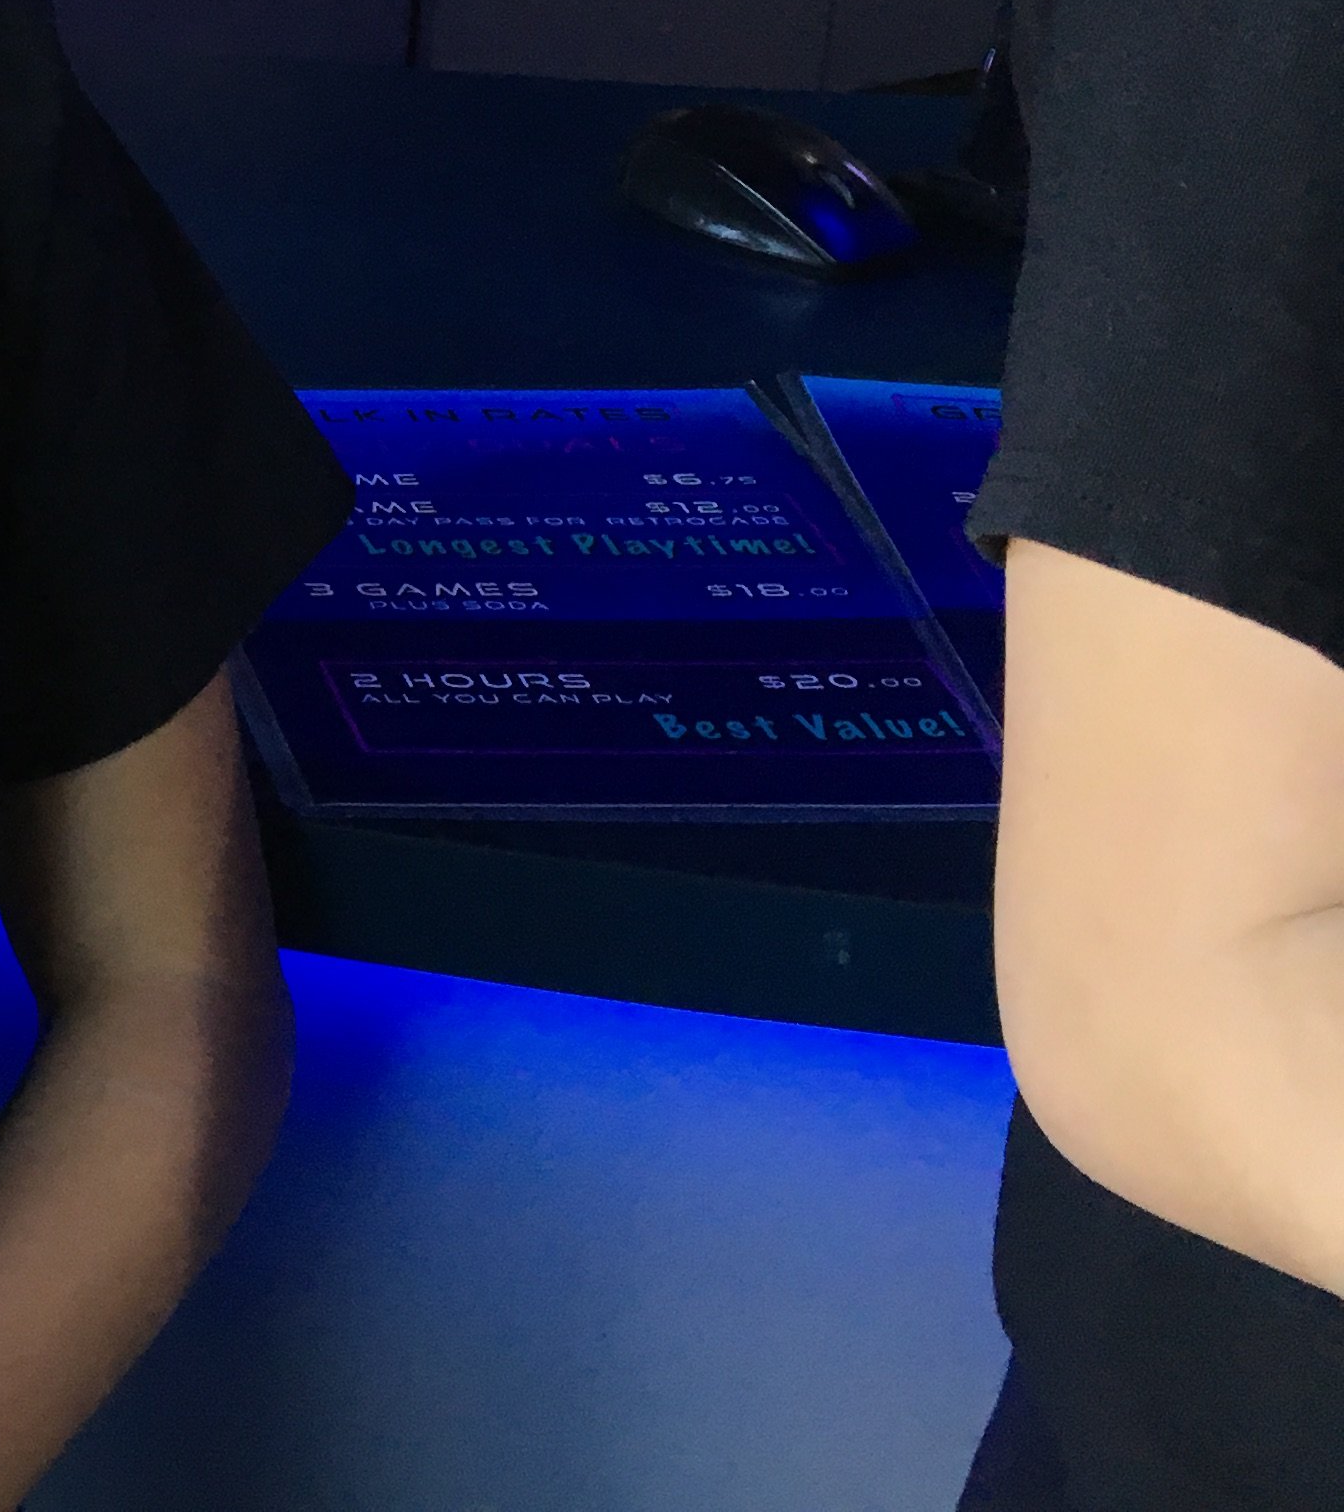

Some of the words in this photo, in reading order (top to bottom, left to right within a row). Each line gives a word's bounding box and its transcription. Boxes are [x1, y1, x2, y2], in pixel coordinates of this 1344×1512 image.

[318, 409, 383, 422] LK
[406, 409, 459, 423] IN
[482, 408, 673, 423] RATES
[355, 473, 420, 486] ME
[642, 472, 758, 486] $6.75
[354, 500, 437, 514] ME
[645, 501, 780, 515] $12.00
[366, 516, 419, 527] DAY
[434, 516, 515, 527] PASS
[526, 516, 587, 527] FOR
[605, 515, 790, 527] RETROCADE
[357, 533, 555, 559] Longest
[571, 531, 816, 559] Playtime!
[303, 582, 335, 597] 3
[355, 581, 539, 597] GAMES
[706, 583, 849, 599] $18.00
[368, 599, 451, 611] PLUS
[462, 599, 550, 611] SODA
[349, 672, 383, 689] 2
[400, 672, 593, 690] HOURS
[758, 673, 924, 691] $20.00
[360, 692, 422, 705] ALL
[431, 692, 500, 705] YOU
[512, 692, 583, 705] CAN
[592, 692, 674, 706] PLAY
[651, 710, 781, 741] Best
[794, 709, 967, 741] Value!
